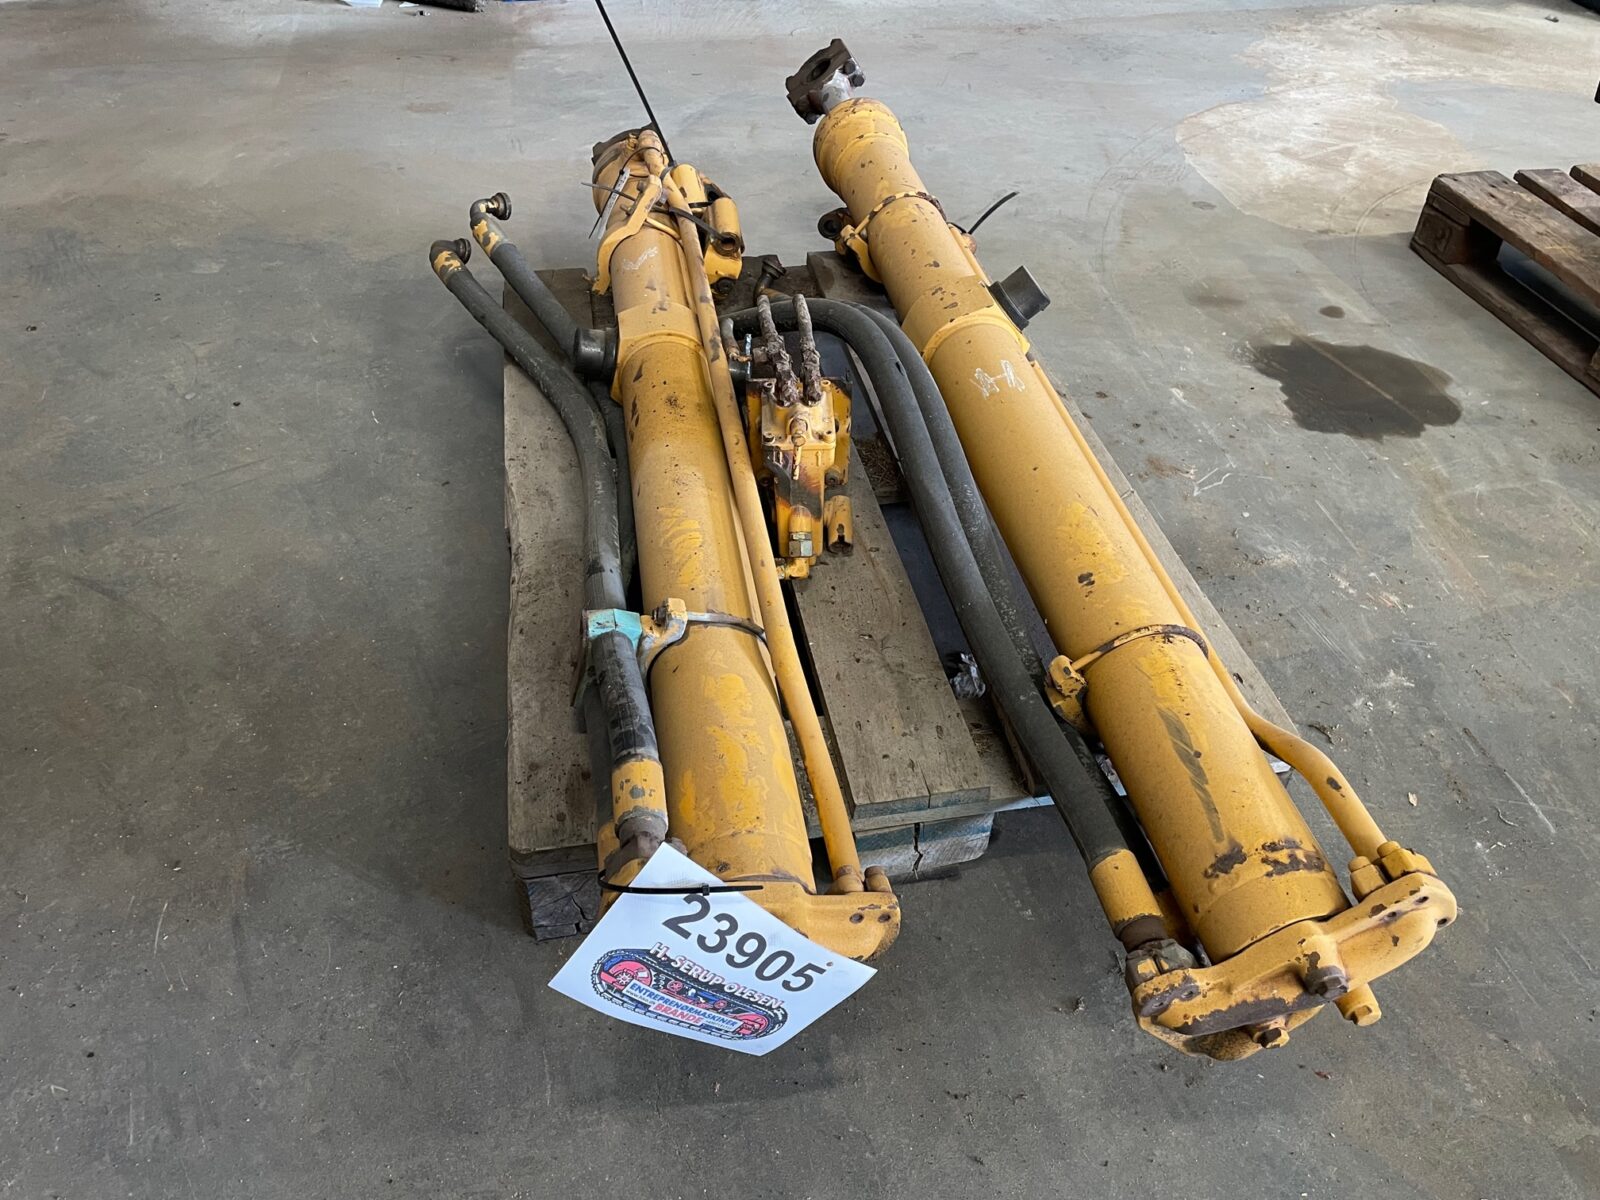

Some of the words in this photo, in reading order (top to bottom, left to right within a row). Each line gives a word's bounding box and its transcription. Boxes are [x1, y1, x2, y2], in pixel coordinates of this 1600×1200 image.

[662, 893, 826, 992] 23905
[629, 983, 738, 1027] ENTREPRENØRMASKINER
[653, 1003, 704, 1025] BRANDE
